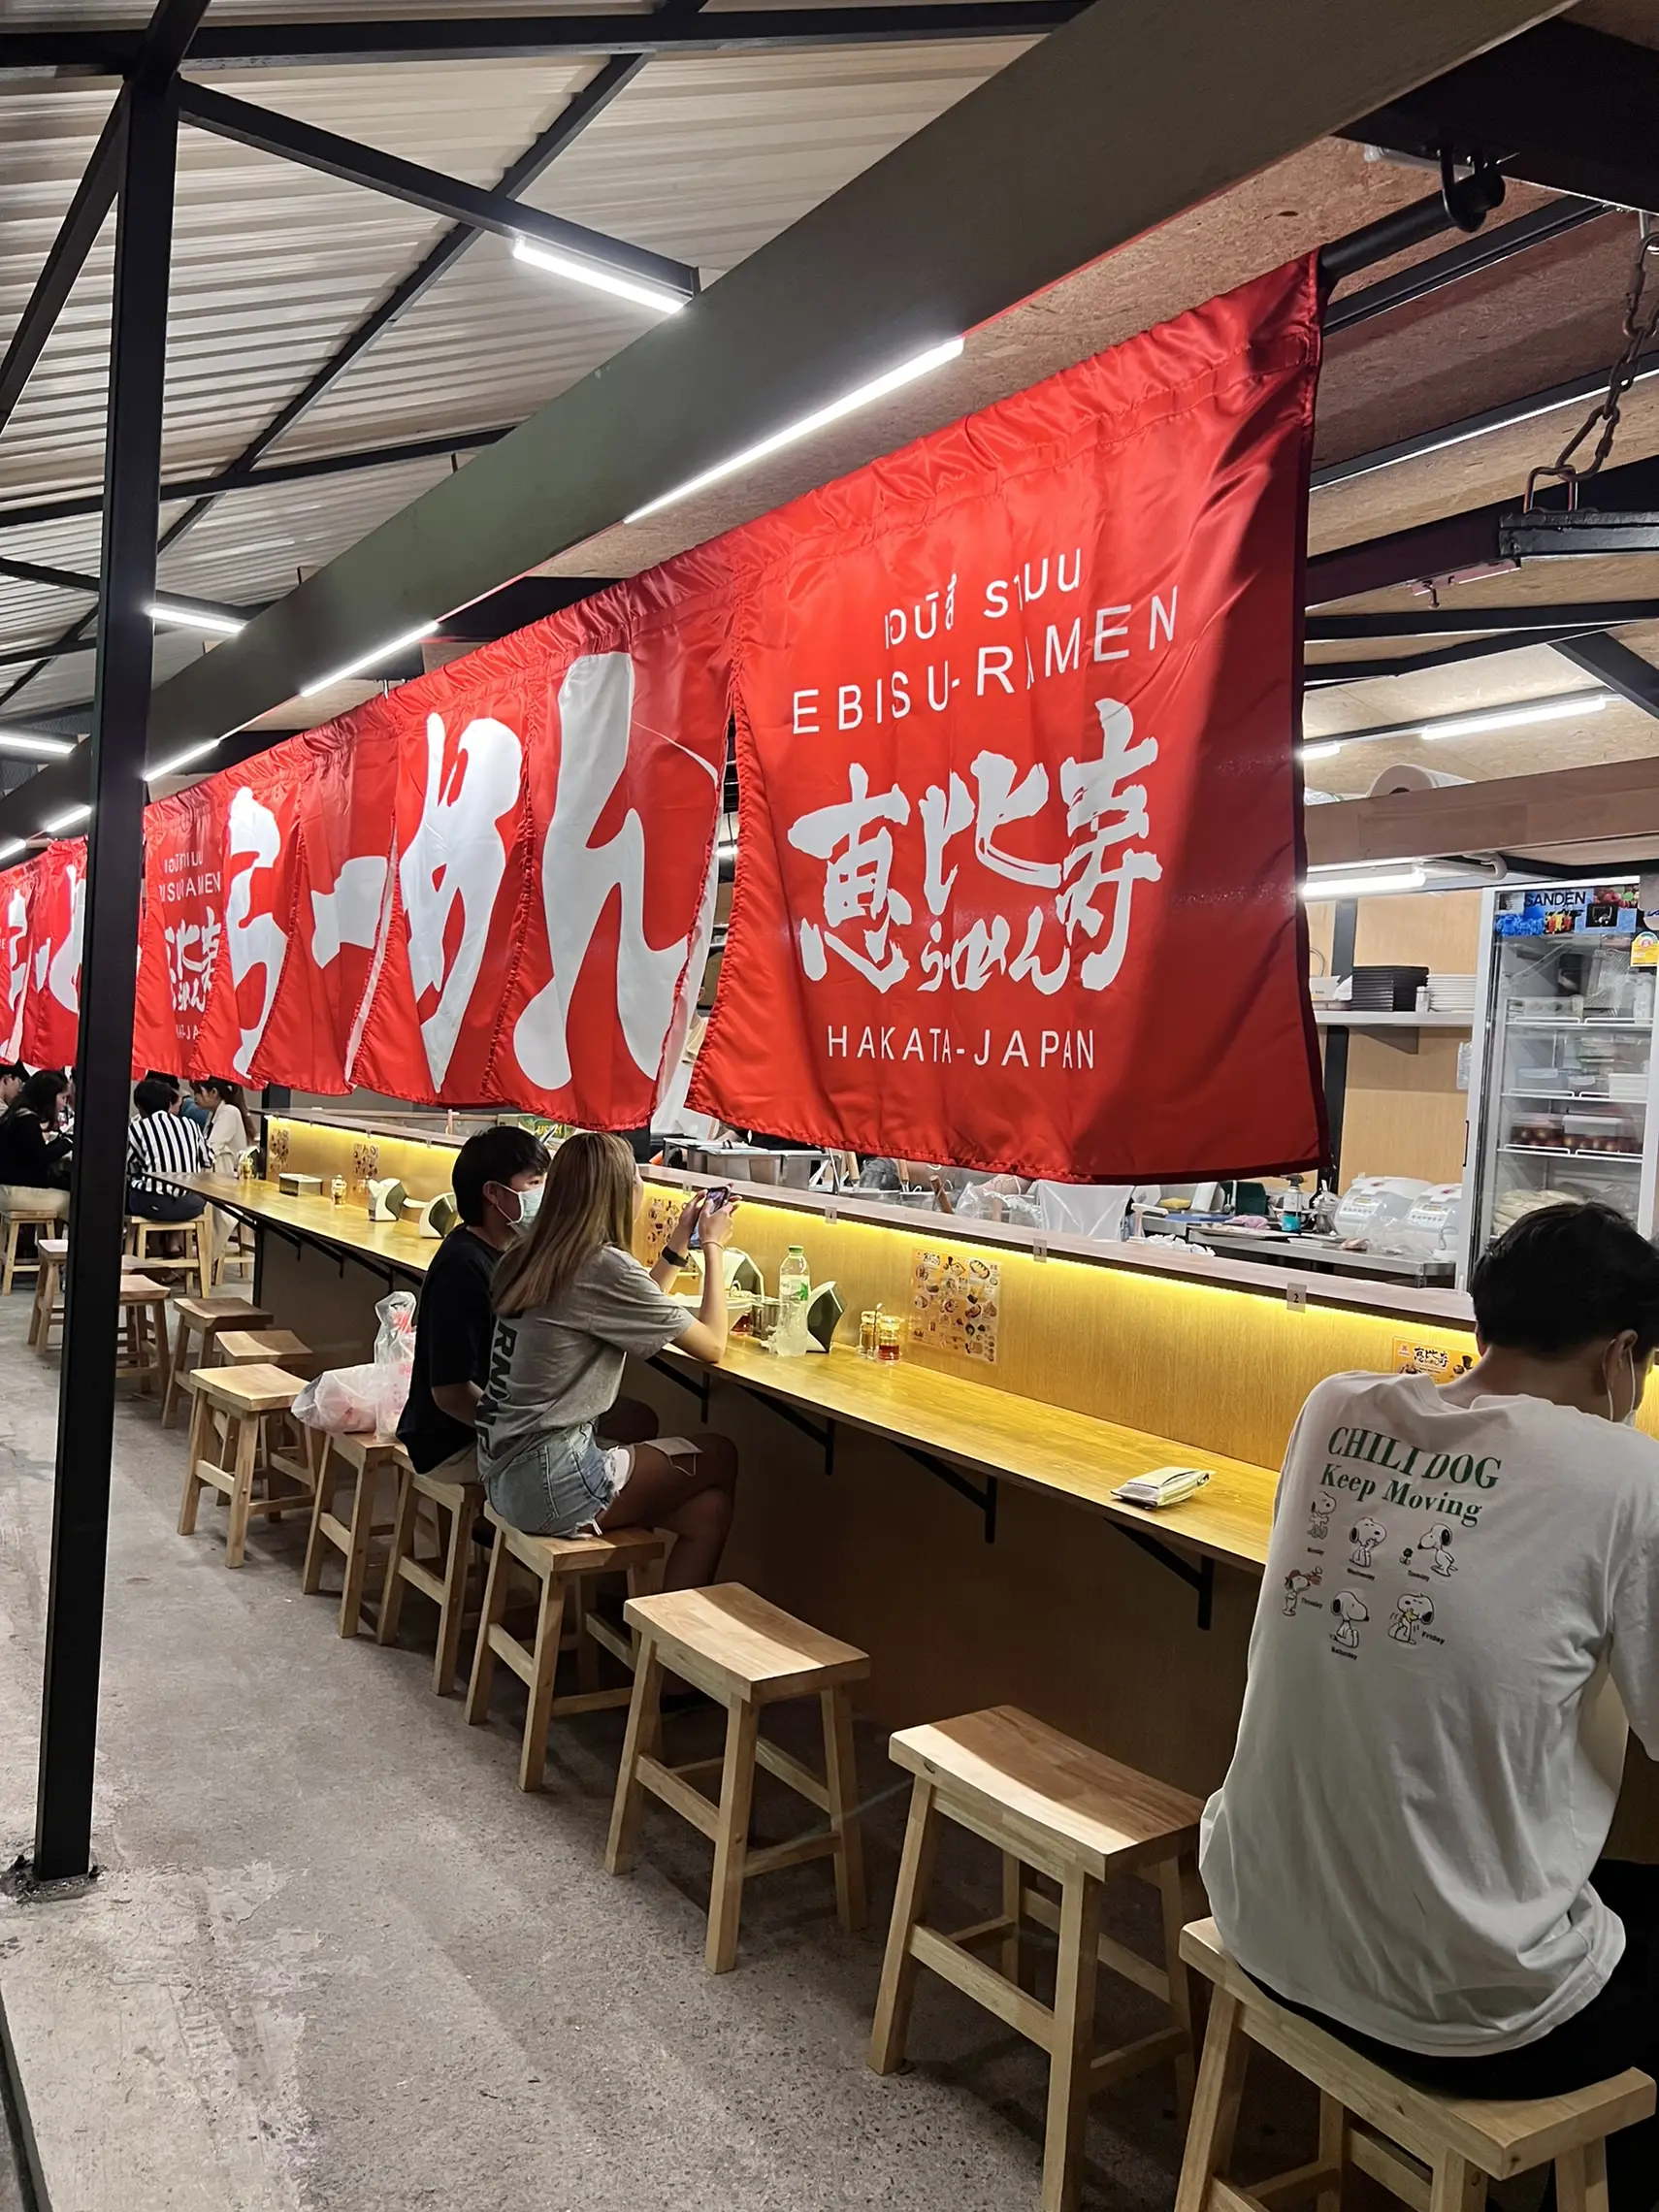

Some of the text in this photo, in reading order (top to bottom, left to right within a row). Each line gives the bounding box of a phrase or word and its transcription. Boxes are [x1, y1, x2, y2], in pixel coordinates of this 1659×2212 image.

[1524, 891, 1586, 907] SANDEN
[827, 1025, 1095, 1069] HAKATA-JAPAN
[1293, 1292, 1300, 1304] 2
[1327, 1426, 1503, 1489] CHILI DOG
[1319, 1463, 1483, 1528] Keep Moving
[1421, 1631, 1445, 1645] Friday
